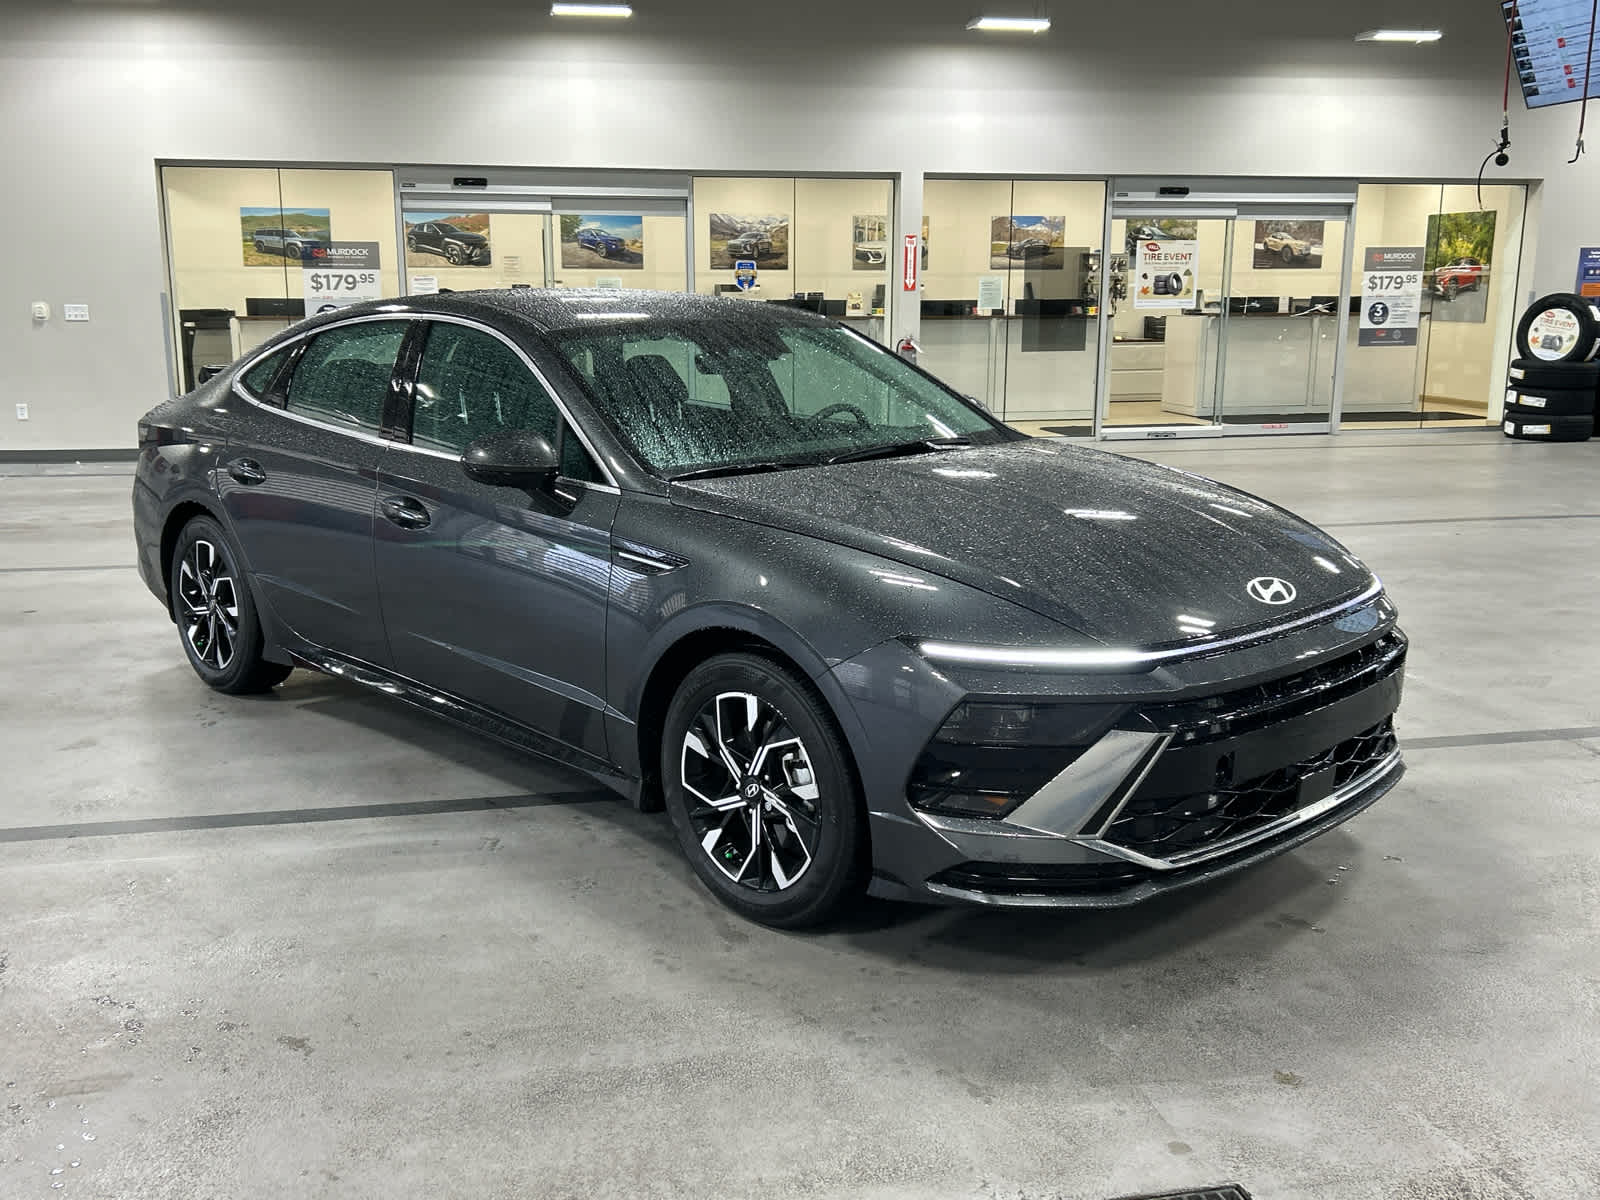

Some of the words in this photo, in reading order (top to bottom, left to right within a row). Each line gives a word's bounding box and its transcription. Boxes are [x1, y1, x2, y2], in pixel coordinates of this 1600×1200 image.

[326, 247, 369, 256] MURDOCK
[1143, 252, 1163, 261] TIRE
[1163, 252, 1193, 261] EVENT
[310, 272, 375, 292] $179.95
[1367, 274, 1418, 292] $179.95
[1373, 303, 1384, 317] 3
